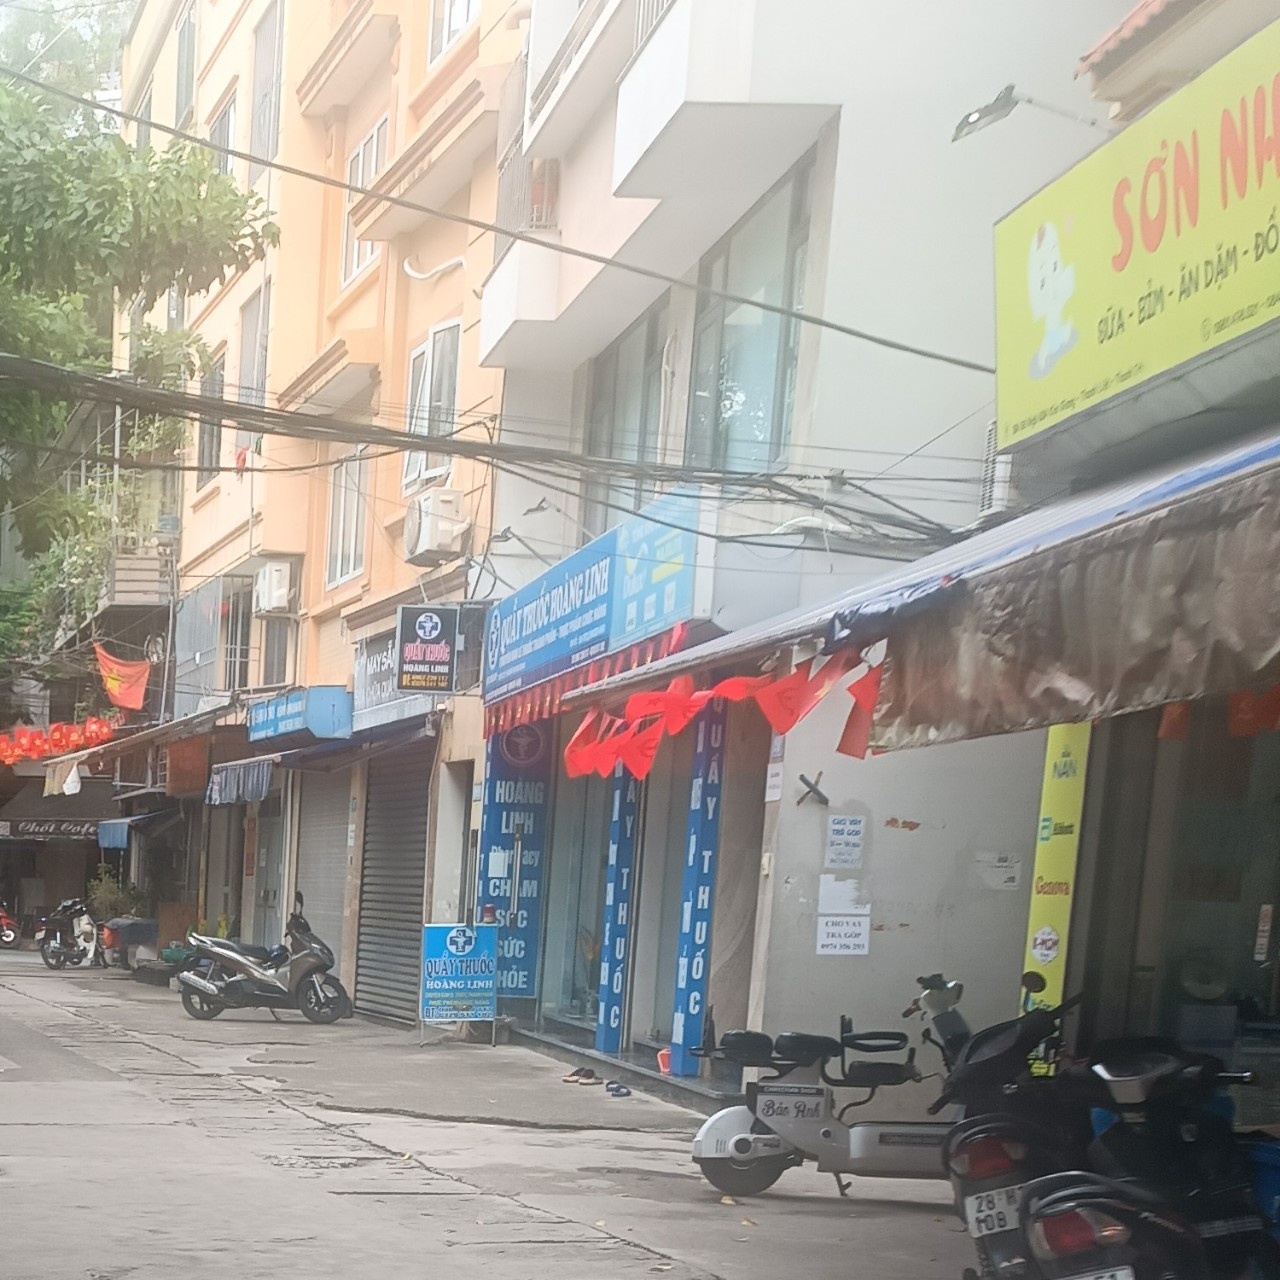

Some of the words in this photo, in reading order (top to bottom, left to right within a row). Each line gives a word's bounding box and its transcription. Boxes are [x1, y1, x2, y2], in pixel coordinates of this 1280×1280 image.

[583, 556, 611, 605] LINH
[489, 878, 538, 898] CHM
[467, 980, 493, 989] LINH
[497, 965, 528, 989] HỎE
